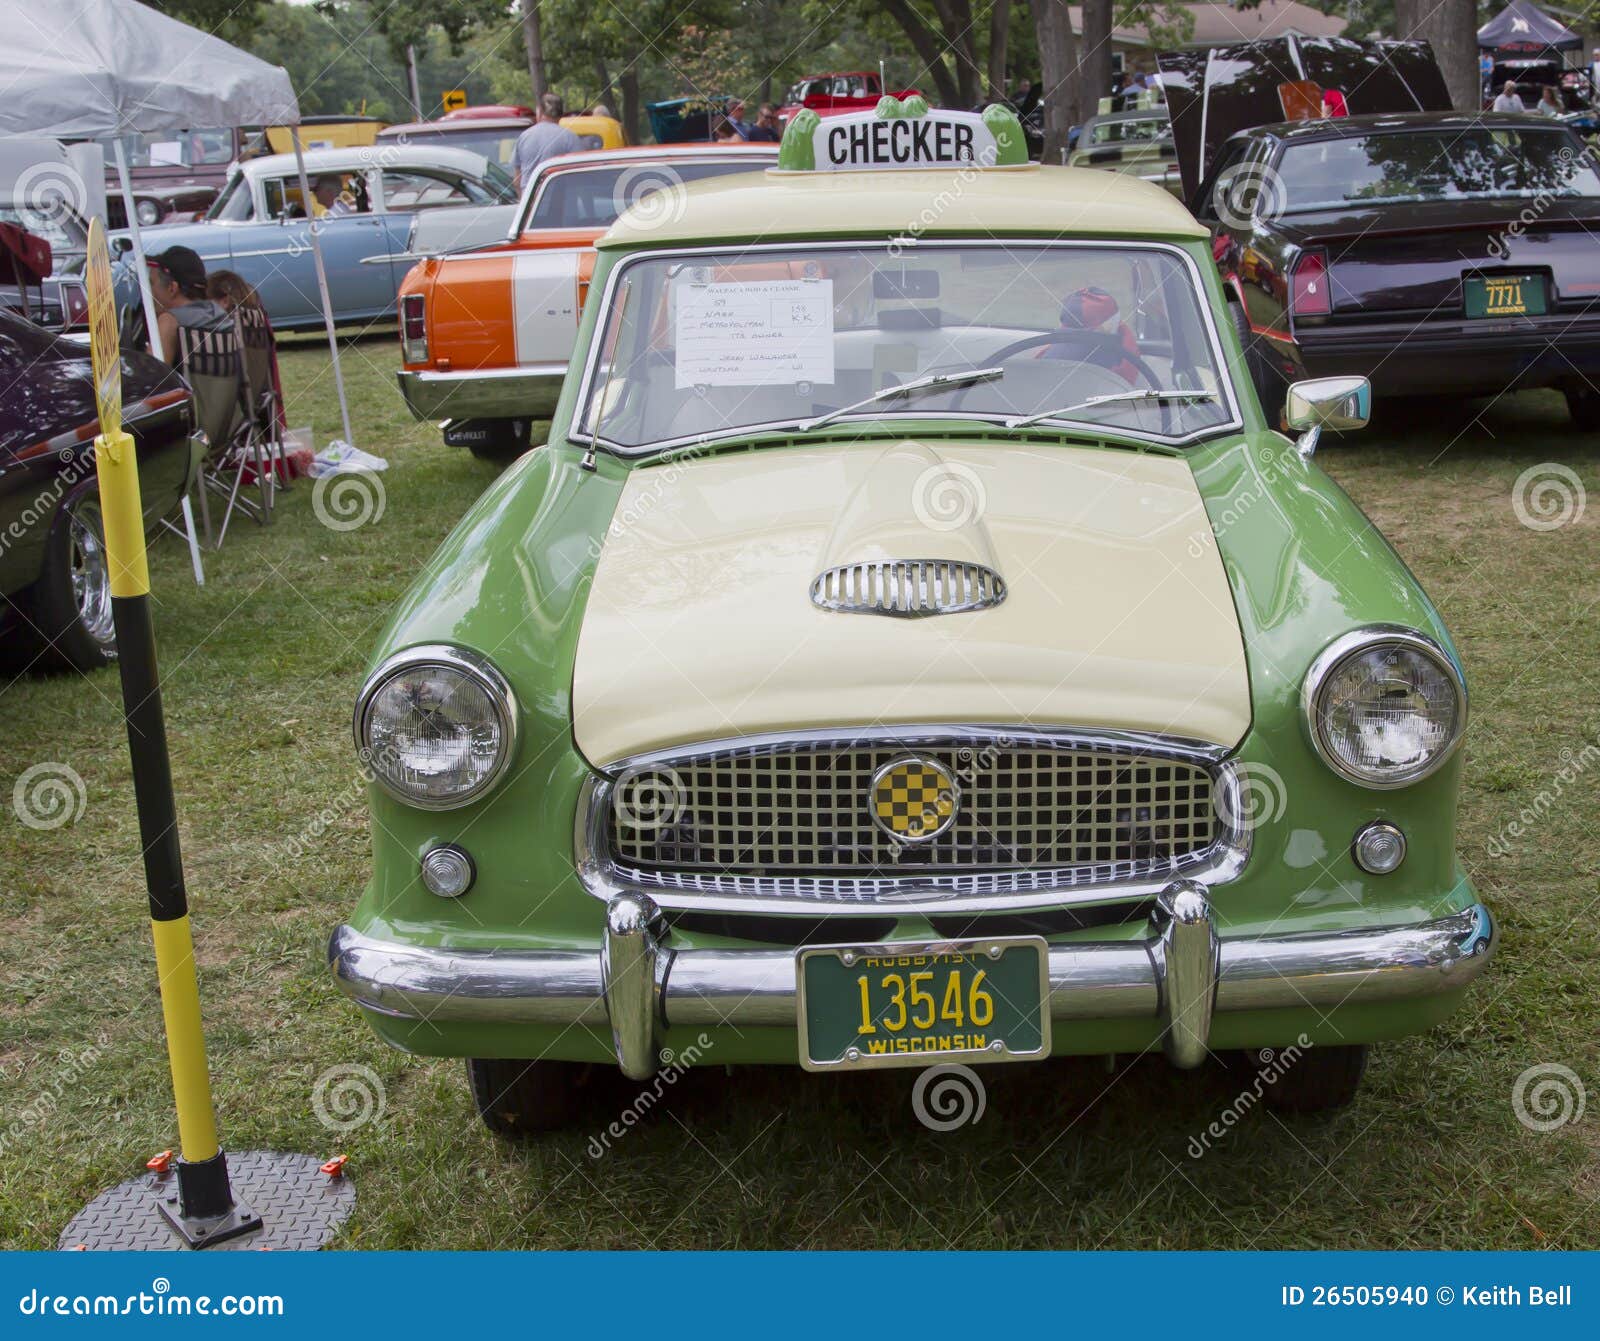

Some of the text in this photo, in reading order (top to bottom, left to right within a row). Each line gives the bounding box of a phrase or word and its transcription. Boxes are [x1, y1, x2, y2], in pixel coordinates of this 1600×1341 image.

[828, 119, 975, 165] CHECKER
[1486, 285, 1524, 307] 7771
[857, 969, 994, 1034] 13546
[868, 1034, 986, 1054] WISCONSIN
